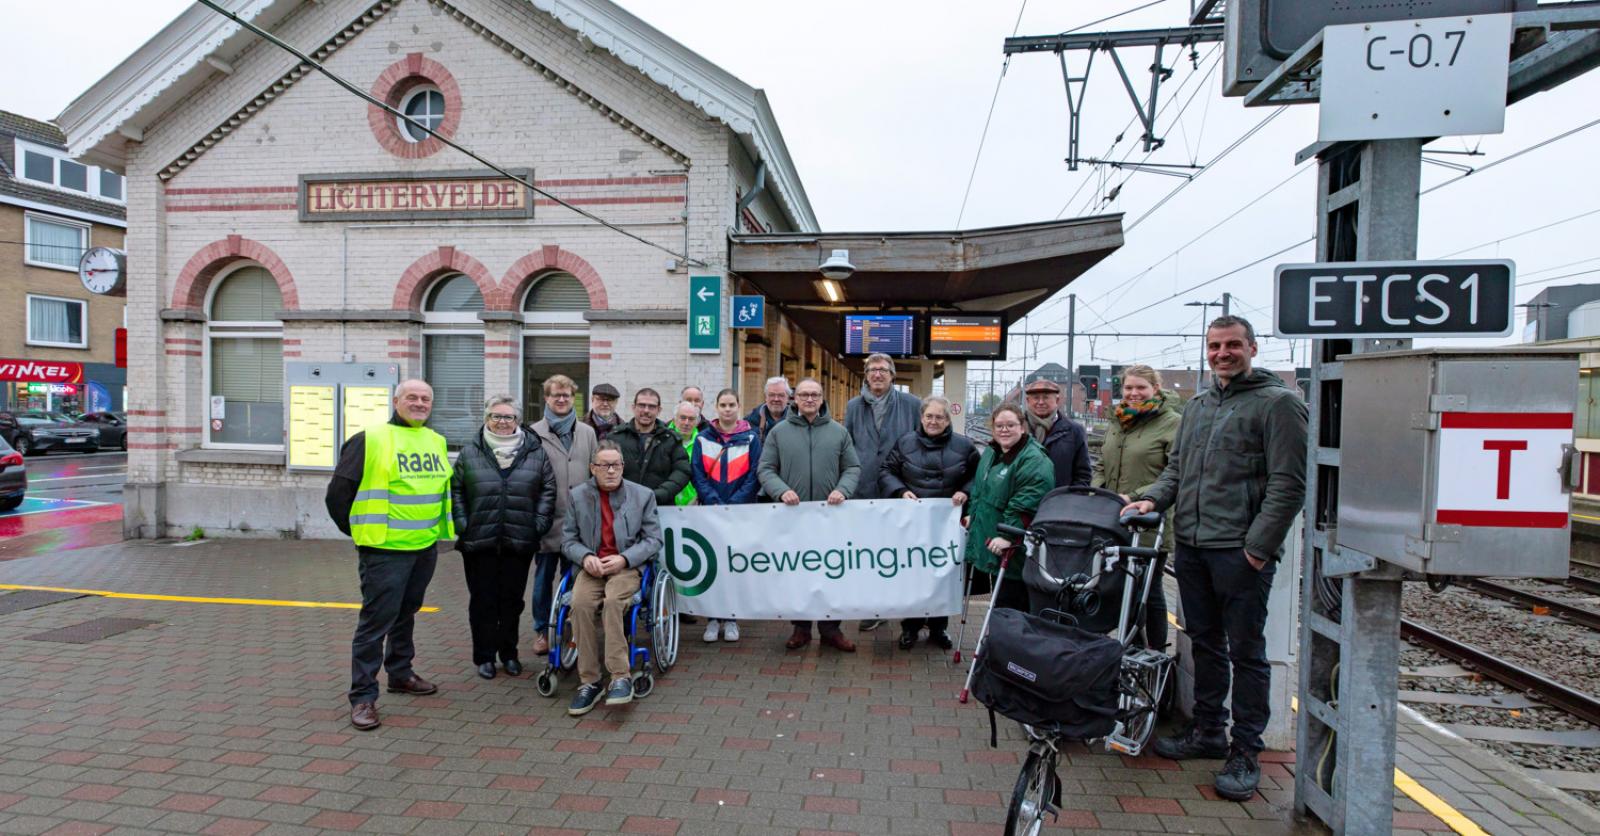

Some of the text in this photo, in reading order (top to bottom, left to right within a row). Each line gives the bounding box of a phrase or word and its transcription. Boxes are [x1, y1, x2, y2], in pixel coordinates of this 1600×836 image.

[315, 183, 519, 210] LICHTERVELDE
[1308, 272, 1480, 327] ETCS1
[1483, 439, 1528, 500] T
[727, 540, 959, 580] beweging.net
